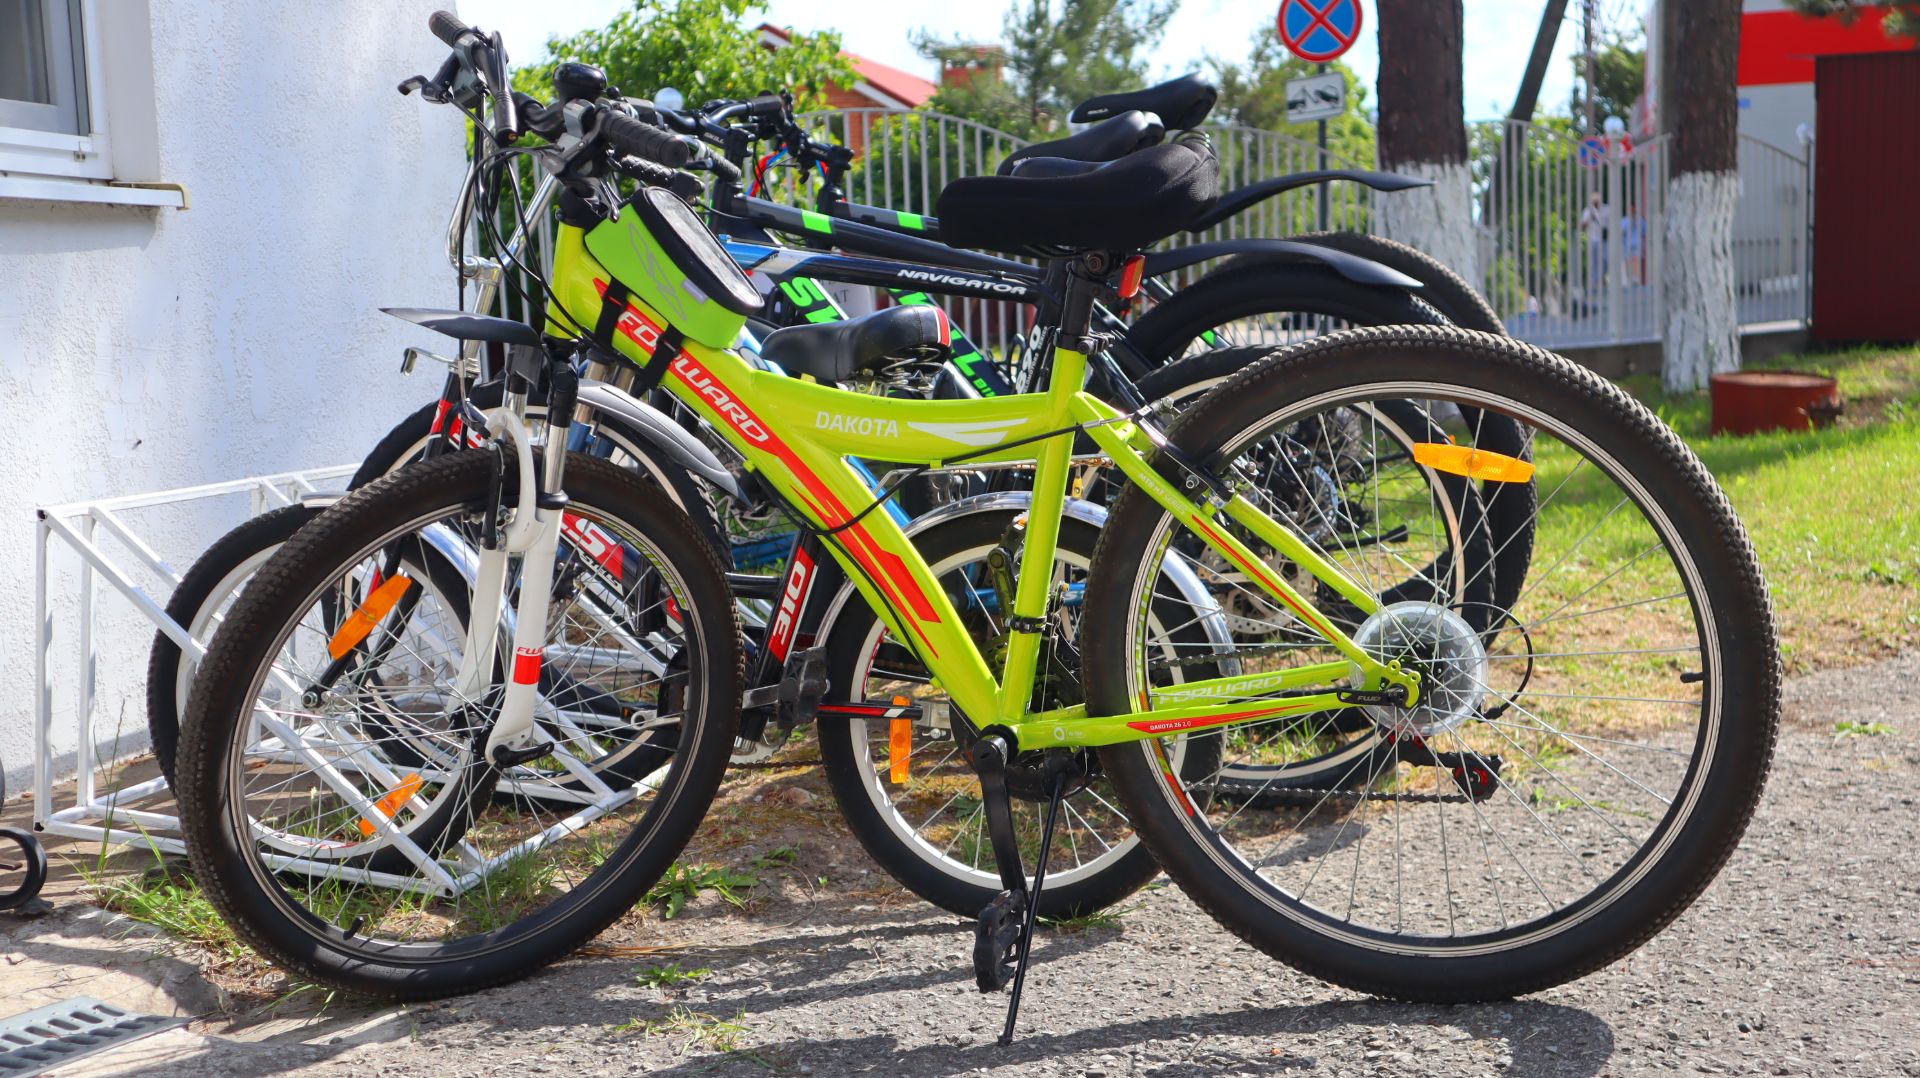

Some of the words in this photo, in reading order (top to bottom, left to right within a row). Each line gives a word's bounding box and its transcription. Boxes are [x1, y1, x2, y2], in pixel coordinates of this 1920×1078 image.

[897, 269, 1027, 295] NAVIGATOR
[617, 311, 769, 443] FOWARD
[815, 411, 899, 438] DAKOTA
[773, 561, 806, 646] 310
[1160, 676, 1282, 704] FORWARD
[1150, 723, 1173, 731] DAKOTA
